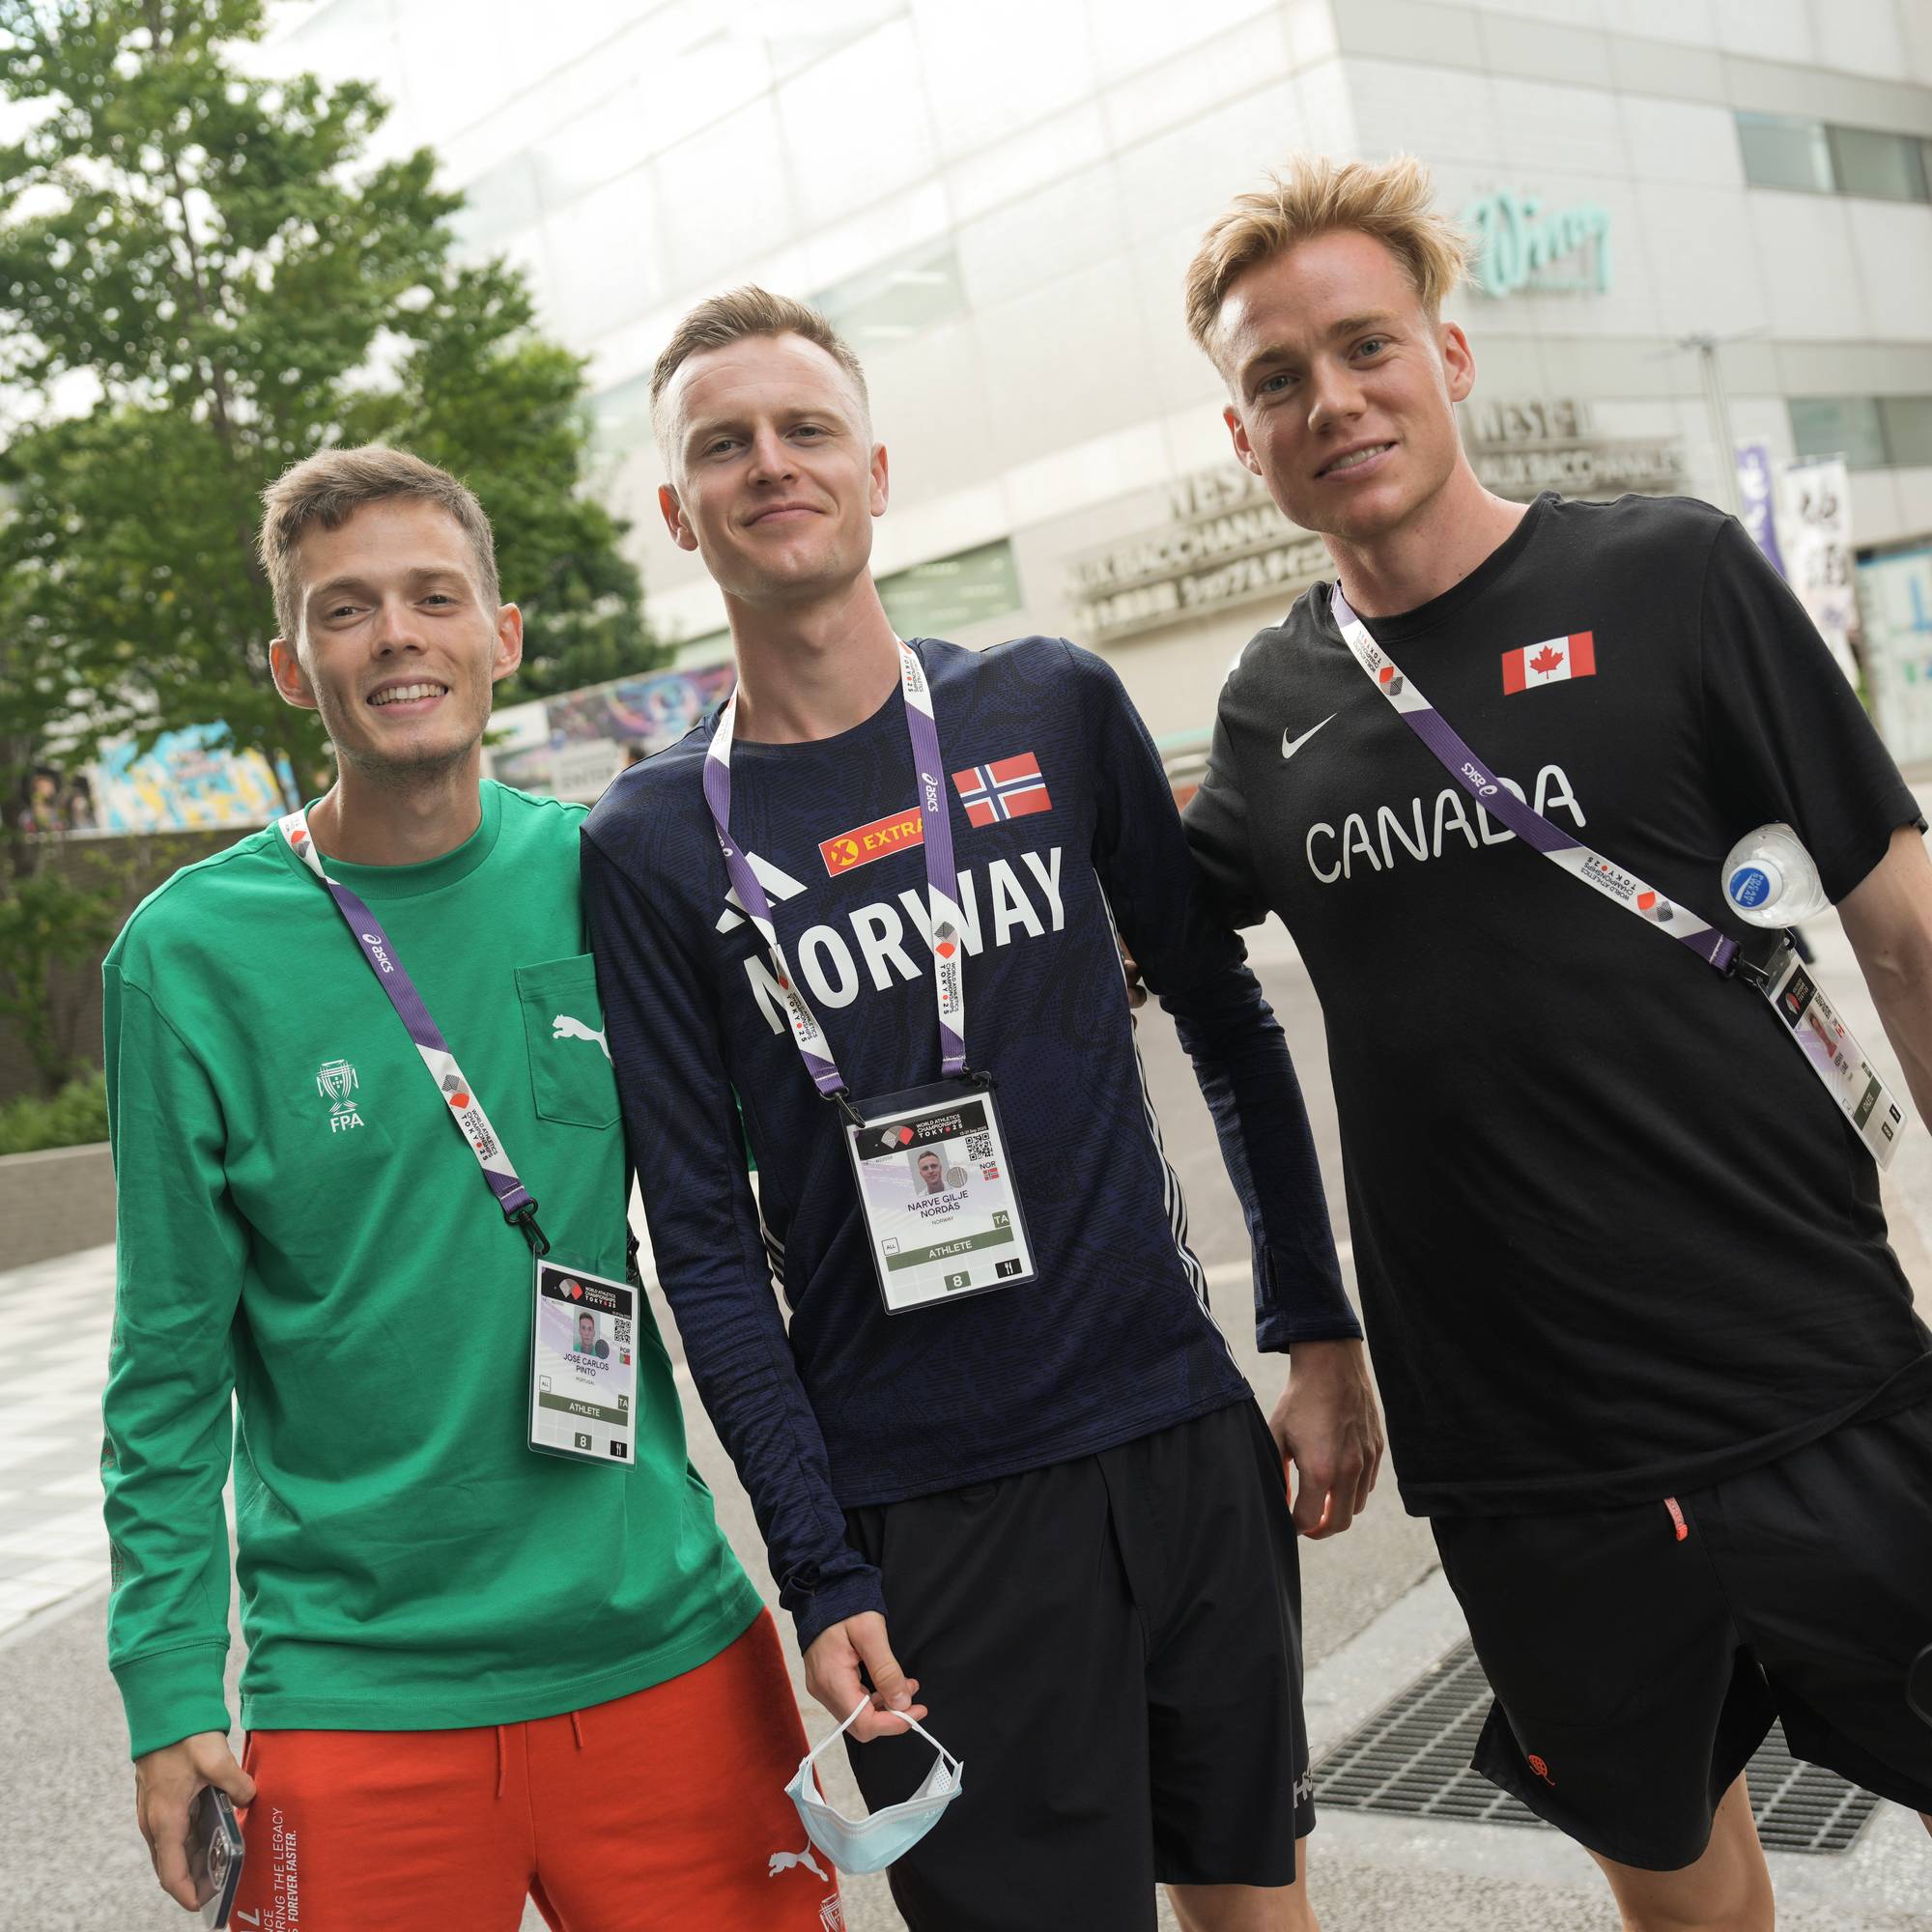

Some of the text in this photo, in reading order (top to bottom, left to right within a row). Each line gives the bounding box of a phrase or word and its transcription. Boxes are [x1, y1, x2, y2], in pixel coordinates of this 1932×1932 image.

[1305, 764, 1587, 884] CANADA
[743, 847, 1065, 1036] NORWAY
[329, 1113, 365, 1133] FPA
[980, 1160, 996, 1170] NOR
[907, 1189, 969, 1211] NARVE GILJE
[993, 1214, 1009, 1224] TA
[928, 1239, 973, 1259] ATHLETE
[952, 1275, 963, 1287] 8
[563, 1352, 610, 1371] JOSÉ CARLOS
[576, 1364, 596, 1377] PINTO
[568, 1402, 601, 1417] ATHLETE
[618, 1397, 628, 1408] TA
[580, 1435, 587, 1448] 8
[271, 1807, 284, 1861] LEGACY
[273, 1864, 285, 1891] THE
